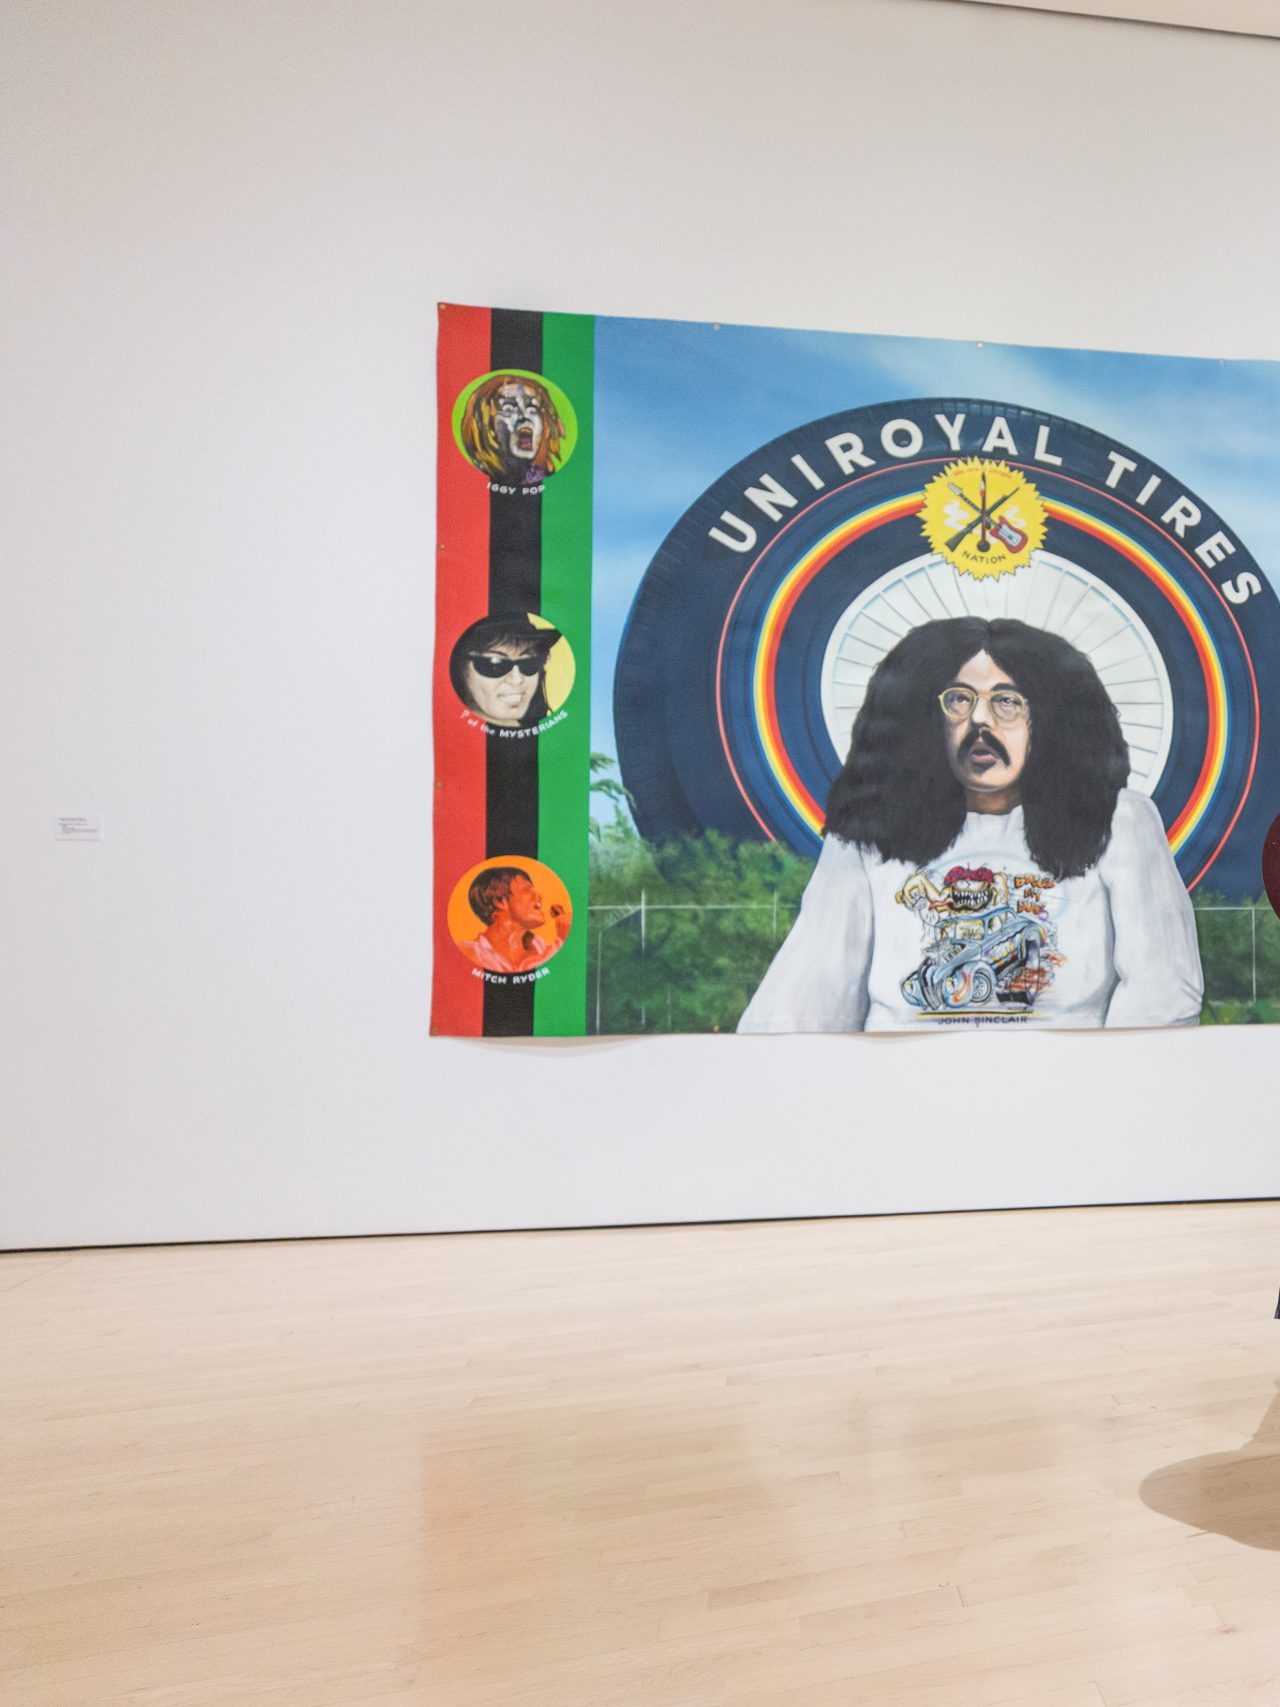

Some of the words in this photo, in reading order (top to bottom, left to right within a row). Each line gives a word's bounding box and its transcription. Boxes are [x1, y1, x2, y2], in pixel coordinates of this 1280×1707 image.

[486, 481, 517, 495] IGGY
[522, 484, 546, 495] POP
[708, 413, 1063, 553] UNIROYAL
[1105, 451, 1262, 605] TIRES
[961, 550, 1007, 565] NATION
[499, 709, 569, 739] MYSTERIANS
[471, 968, 508, 985] MITCH
[512, 967, 551, 984] RYDER
[938, 1016, 969, 1025] JOHN
[974, 1015, 1028, 1025] SINCLAIR
